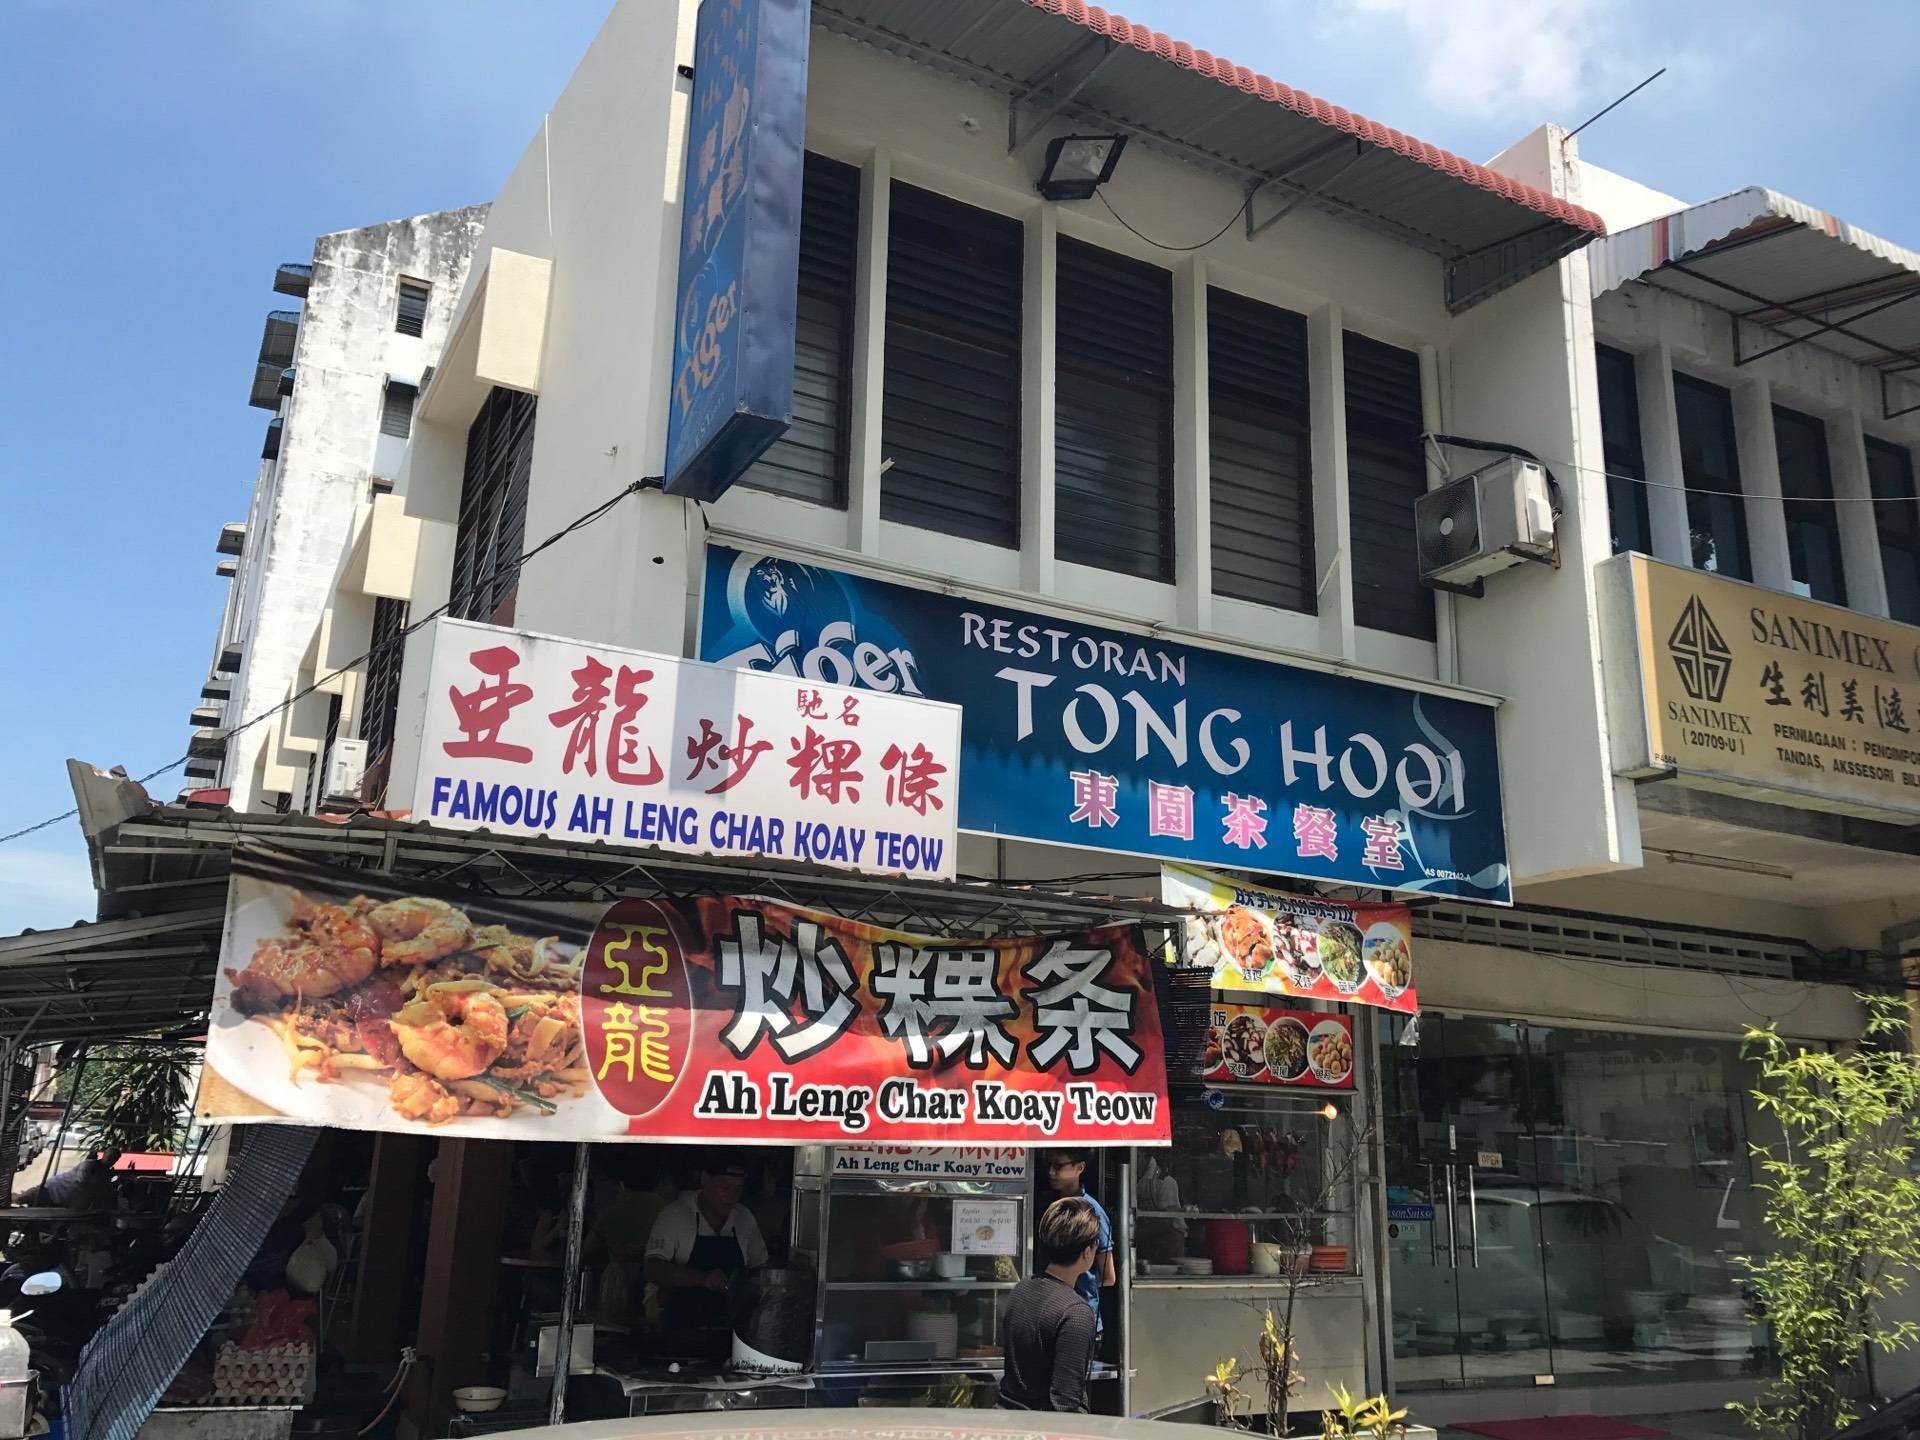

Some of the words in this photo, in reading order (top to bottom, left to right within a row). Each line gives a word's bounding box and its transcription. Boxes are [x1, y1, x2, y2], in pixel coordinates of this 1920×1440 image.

[960, 612, 1186, 687] RESTORAN
[1750, 607, 1896, 674] SANIMEX
[995, 667, 1251, 776] TONG
[1280, 719, 1466, 812] HOOI
[1668, 700, 1752, 735] SANIMEX
[1774, 723, 1847, 751] PERNIAGAAN
[1833, 758, 1895, 782] AKSSESORI
[431, 776, 558, 831] FAMOUS
[567, 798, 613, 836] AH
[624, 800, 699, 845] LENG
[710, 811, 784, 855] CHAR
[793, 820, 867, 864] KOAY
[874, 830, 943, 873] TEOW
[1069, 768, 1405, 872] 東園茶餐室
[714, 908, 1145, 1076] 炒粿条
[698, 1074, 758, 1115] Ah
[770, 1076, 870, 1130] Leng
[878, 1080, 965, 1121] Char
[975, 1083, 1062, 1131] Koay
[1073, 1086, 1156, 1122] Teow
[836, 1156, 859, 1170] Ah
[863, 1158, 900, 1173] Leng
[903, 1159, 940, 1173] Char
[943, 1160, 981, 1175] Koay
[984, 1162, 1025, 1176] Teow
